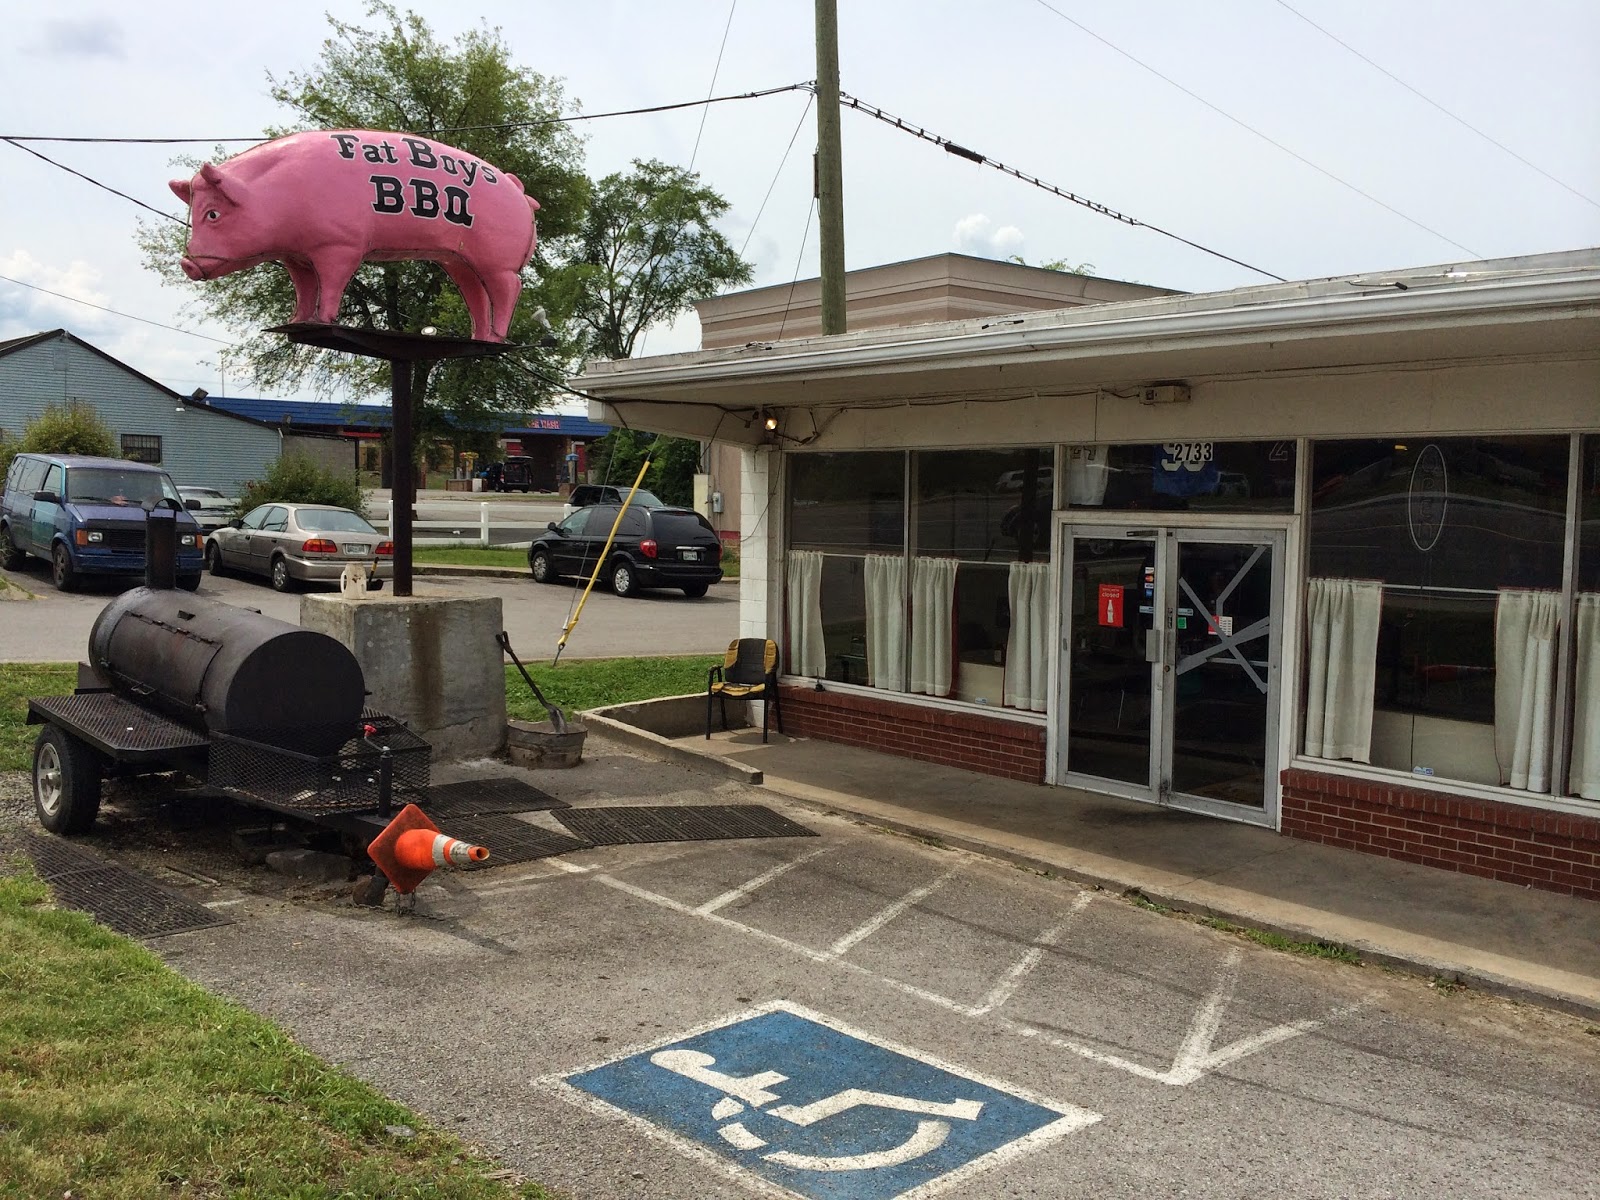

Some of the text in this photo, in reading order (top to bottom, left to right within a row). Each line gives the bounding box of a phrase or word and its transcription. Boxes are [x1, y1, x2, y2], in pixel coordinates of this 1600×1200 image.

[330, 134, 399, 164] Fat
[369, 175, 474, 228] BBQ
[1174, 443, 1213, 461] 2733
